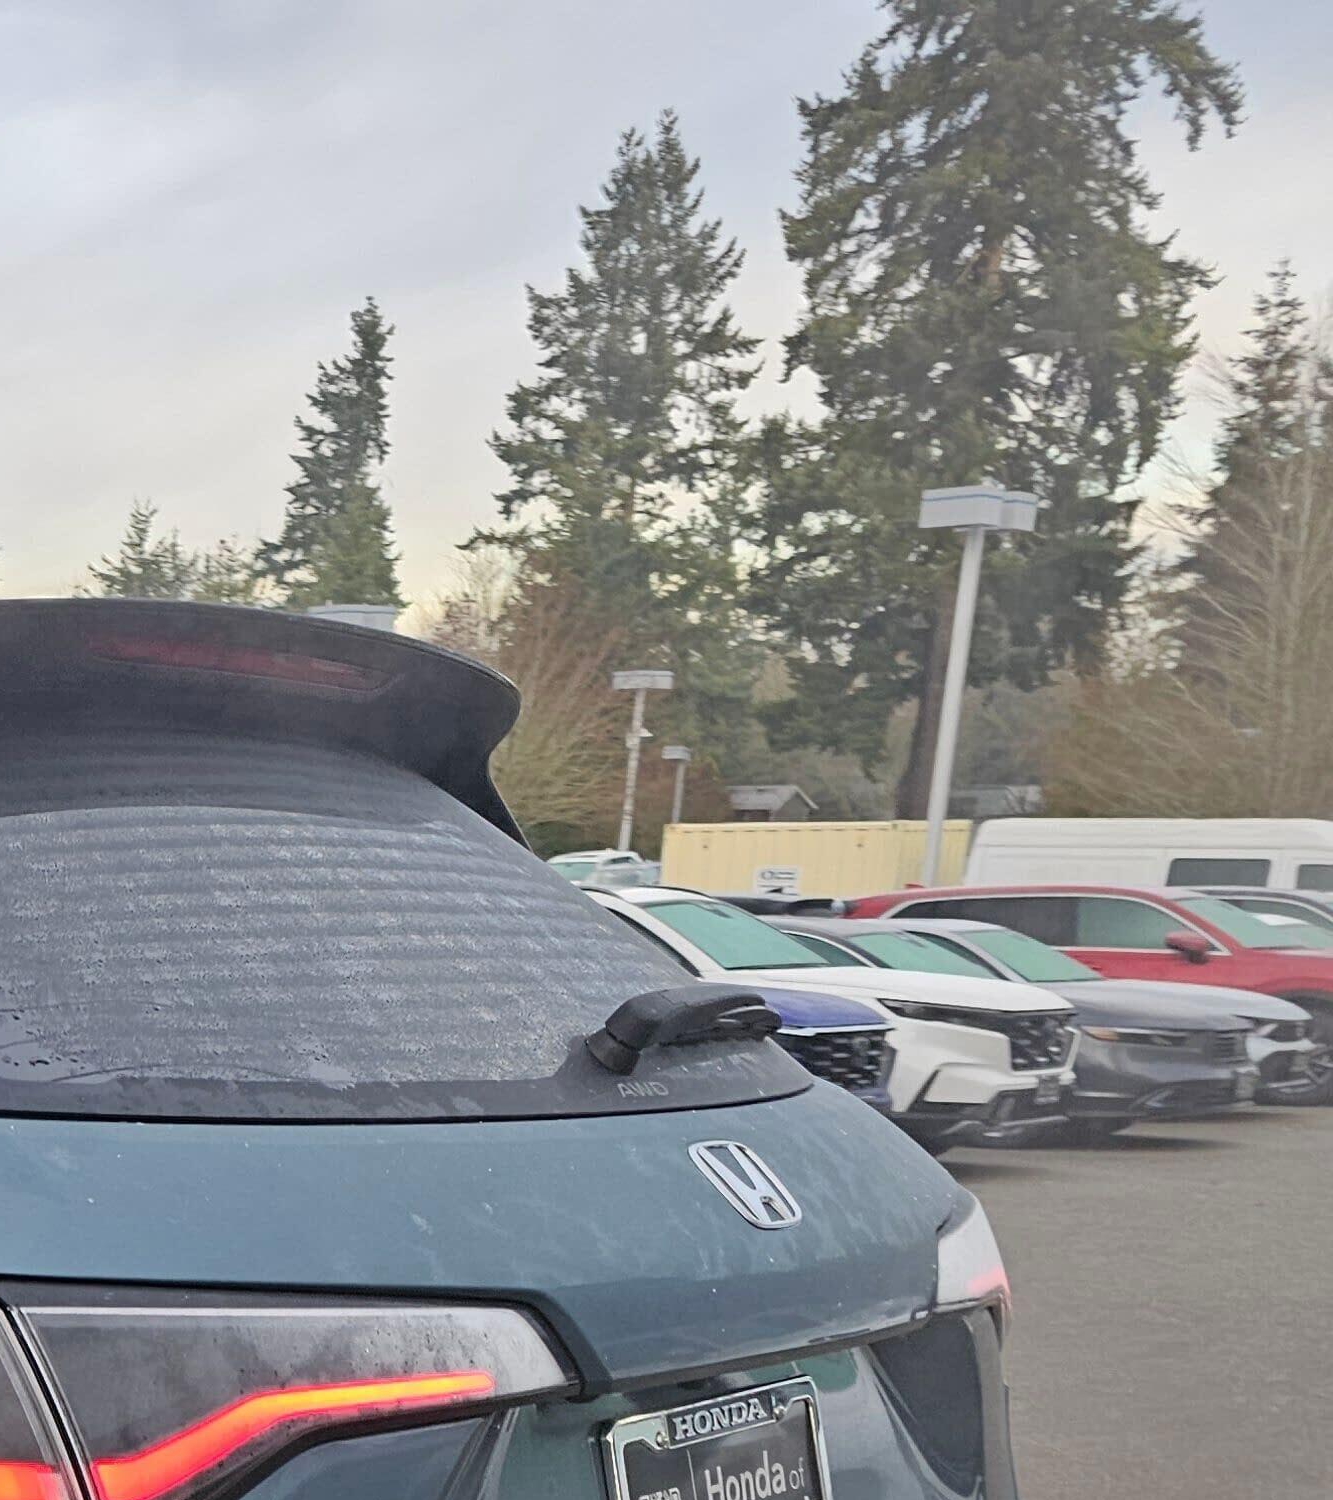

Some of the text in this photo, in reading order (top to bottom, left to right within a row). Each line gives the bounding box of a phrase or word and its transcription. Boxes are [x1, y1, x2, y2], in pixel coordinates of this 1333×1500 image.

[617, 1081, 669, 1098] AWD
[672, 1397, 767, 1441] HONDA
[789, 1457, 806, 1490] of
